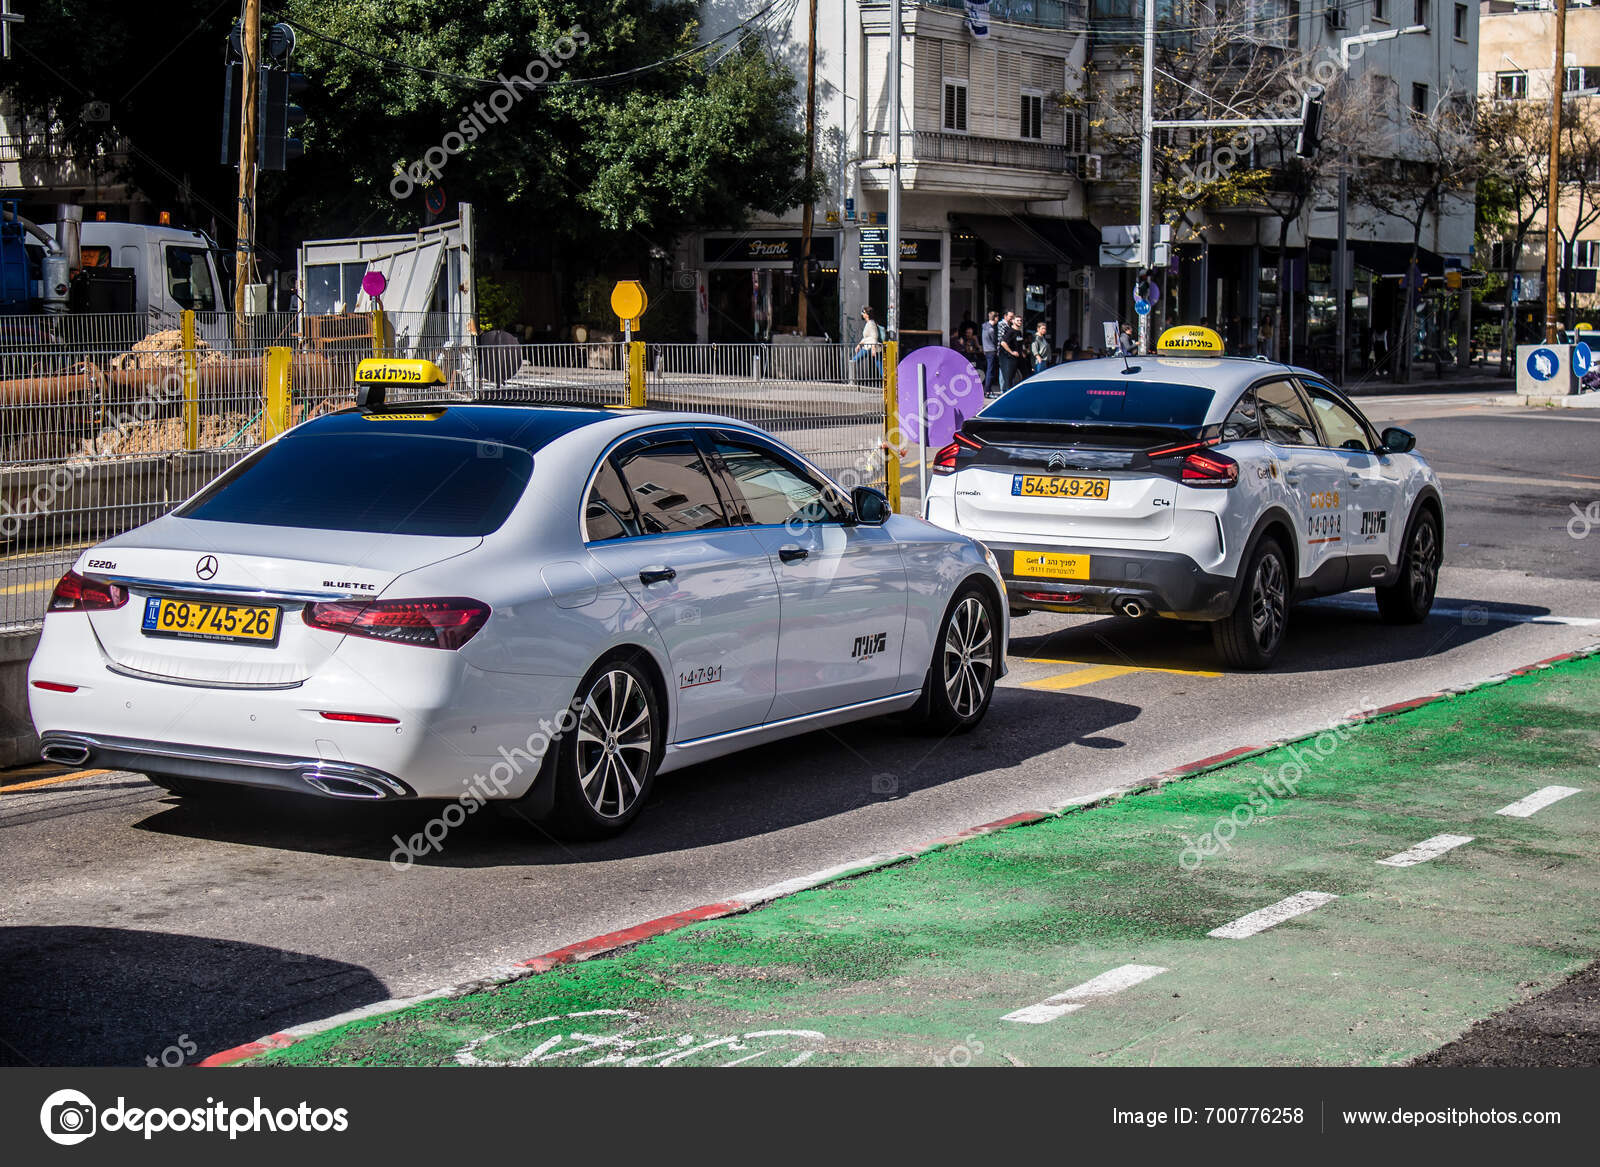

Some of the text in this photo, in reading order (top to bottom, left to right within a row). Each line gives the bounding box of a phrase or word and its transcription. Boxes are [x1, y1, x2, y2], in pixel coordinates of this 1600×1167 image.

[1164, 335, 1184, 348] taxi
[358, 364, 422, 381] taxi מונית
[1153, 498, 1170, 506] C4
[88, 559, 117, 570] E220d
[323, 580, 375, 591] BLUETEC
